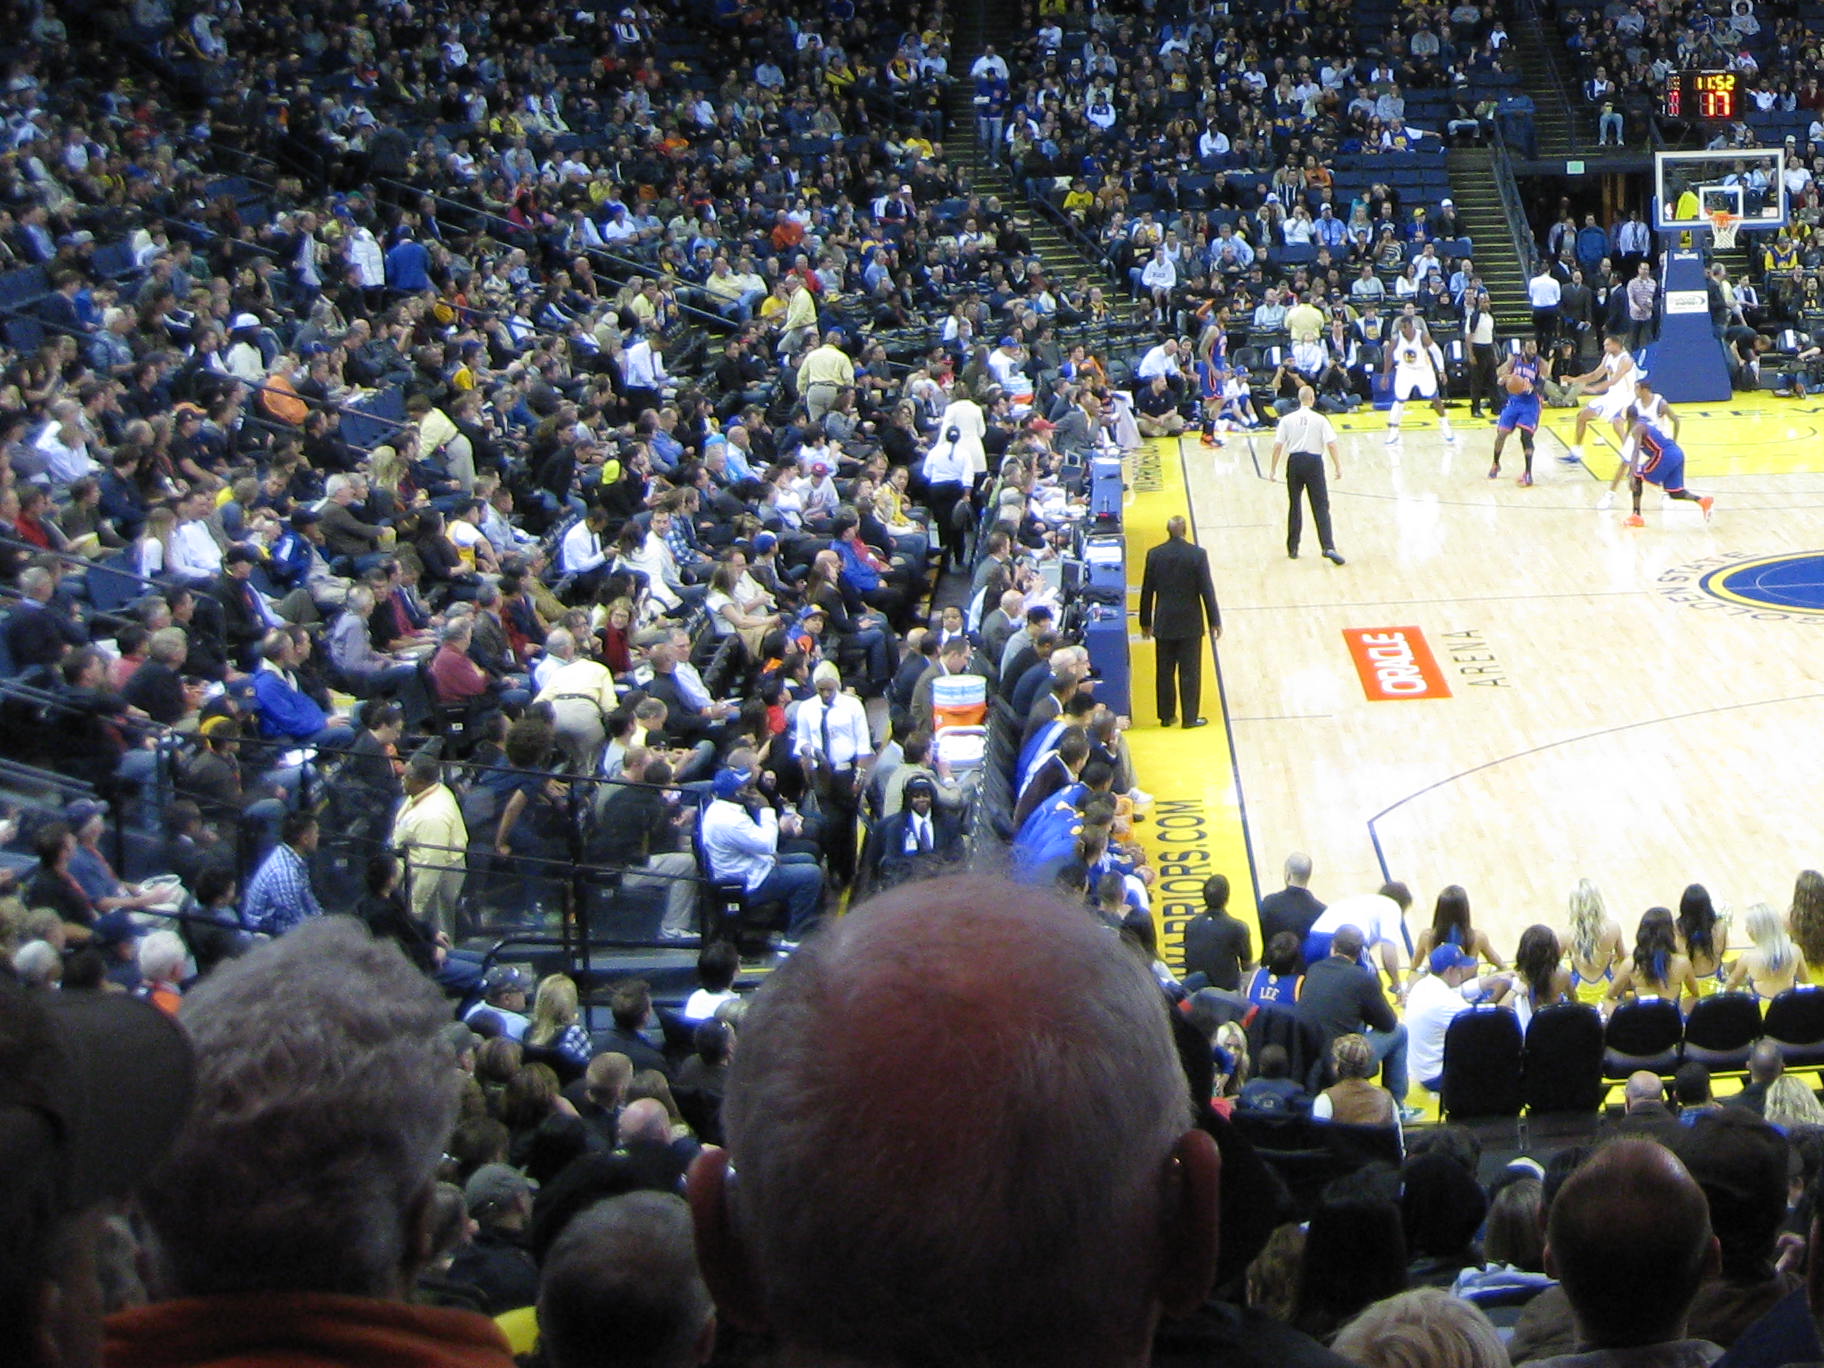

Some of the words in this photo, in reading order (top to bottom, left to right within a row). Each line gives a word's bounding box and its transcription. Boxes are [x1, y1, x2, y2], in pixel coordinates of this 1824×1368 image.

[1697, 75, 1735, 91] 11:52
[1708, 91, 1731, 116] 17
[1361, 631, 1429, 695] ORACLE
[1441, 629, 1512, 689] ARENA
[1259, 985, 1282, 1002] LEE
